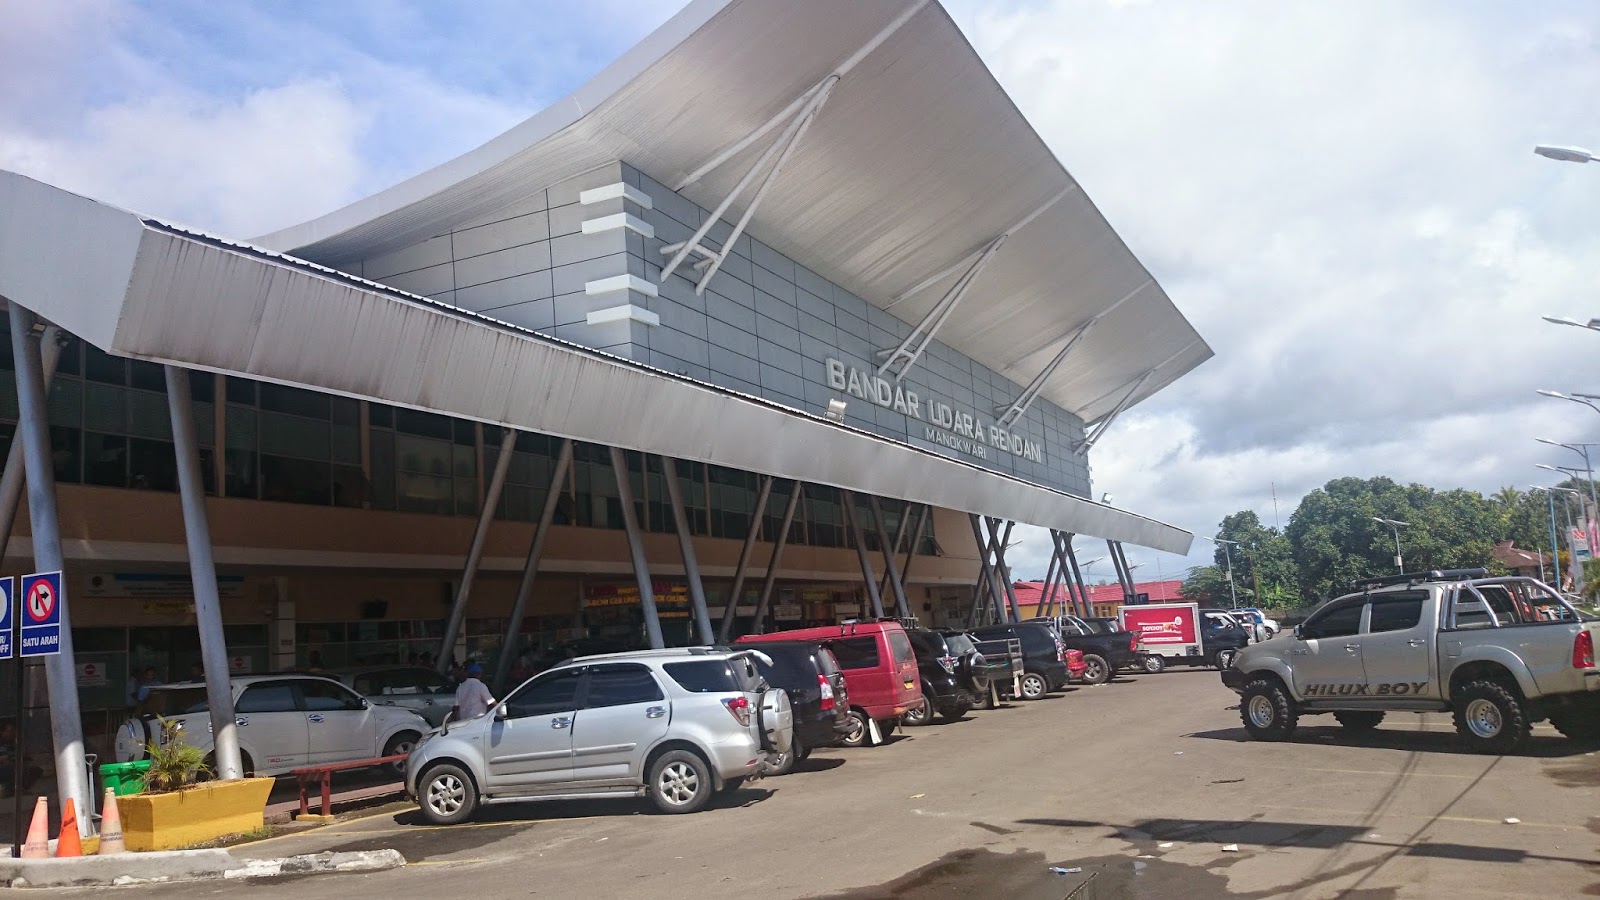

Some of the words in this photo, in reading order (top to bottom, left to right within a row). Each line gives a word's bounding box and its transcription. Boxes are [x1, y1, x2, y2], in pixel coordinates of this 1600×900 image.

[826, 357, 920, 419] BANDAR
[927, 399, 986, 442] UDARA
[988, 425, 1042, 464] RENDANI
[925, 427, 987, 459] MANOKWARI
[22, 637, 39, 647] SATU
[40, 635, 58, 645] ARAH
[1303, 683, 1370, 696] HILUX
[1375, 681, 1428, 695] BOY
